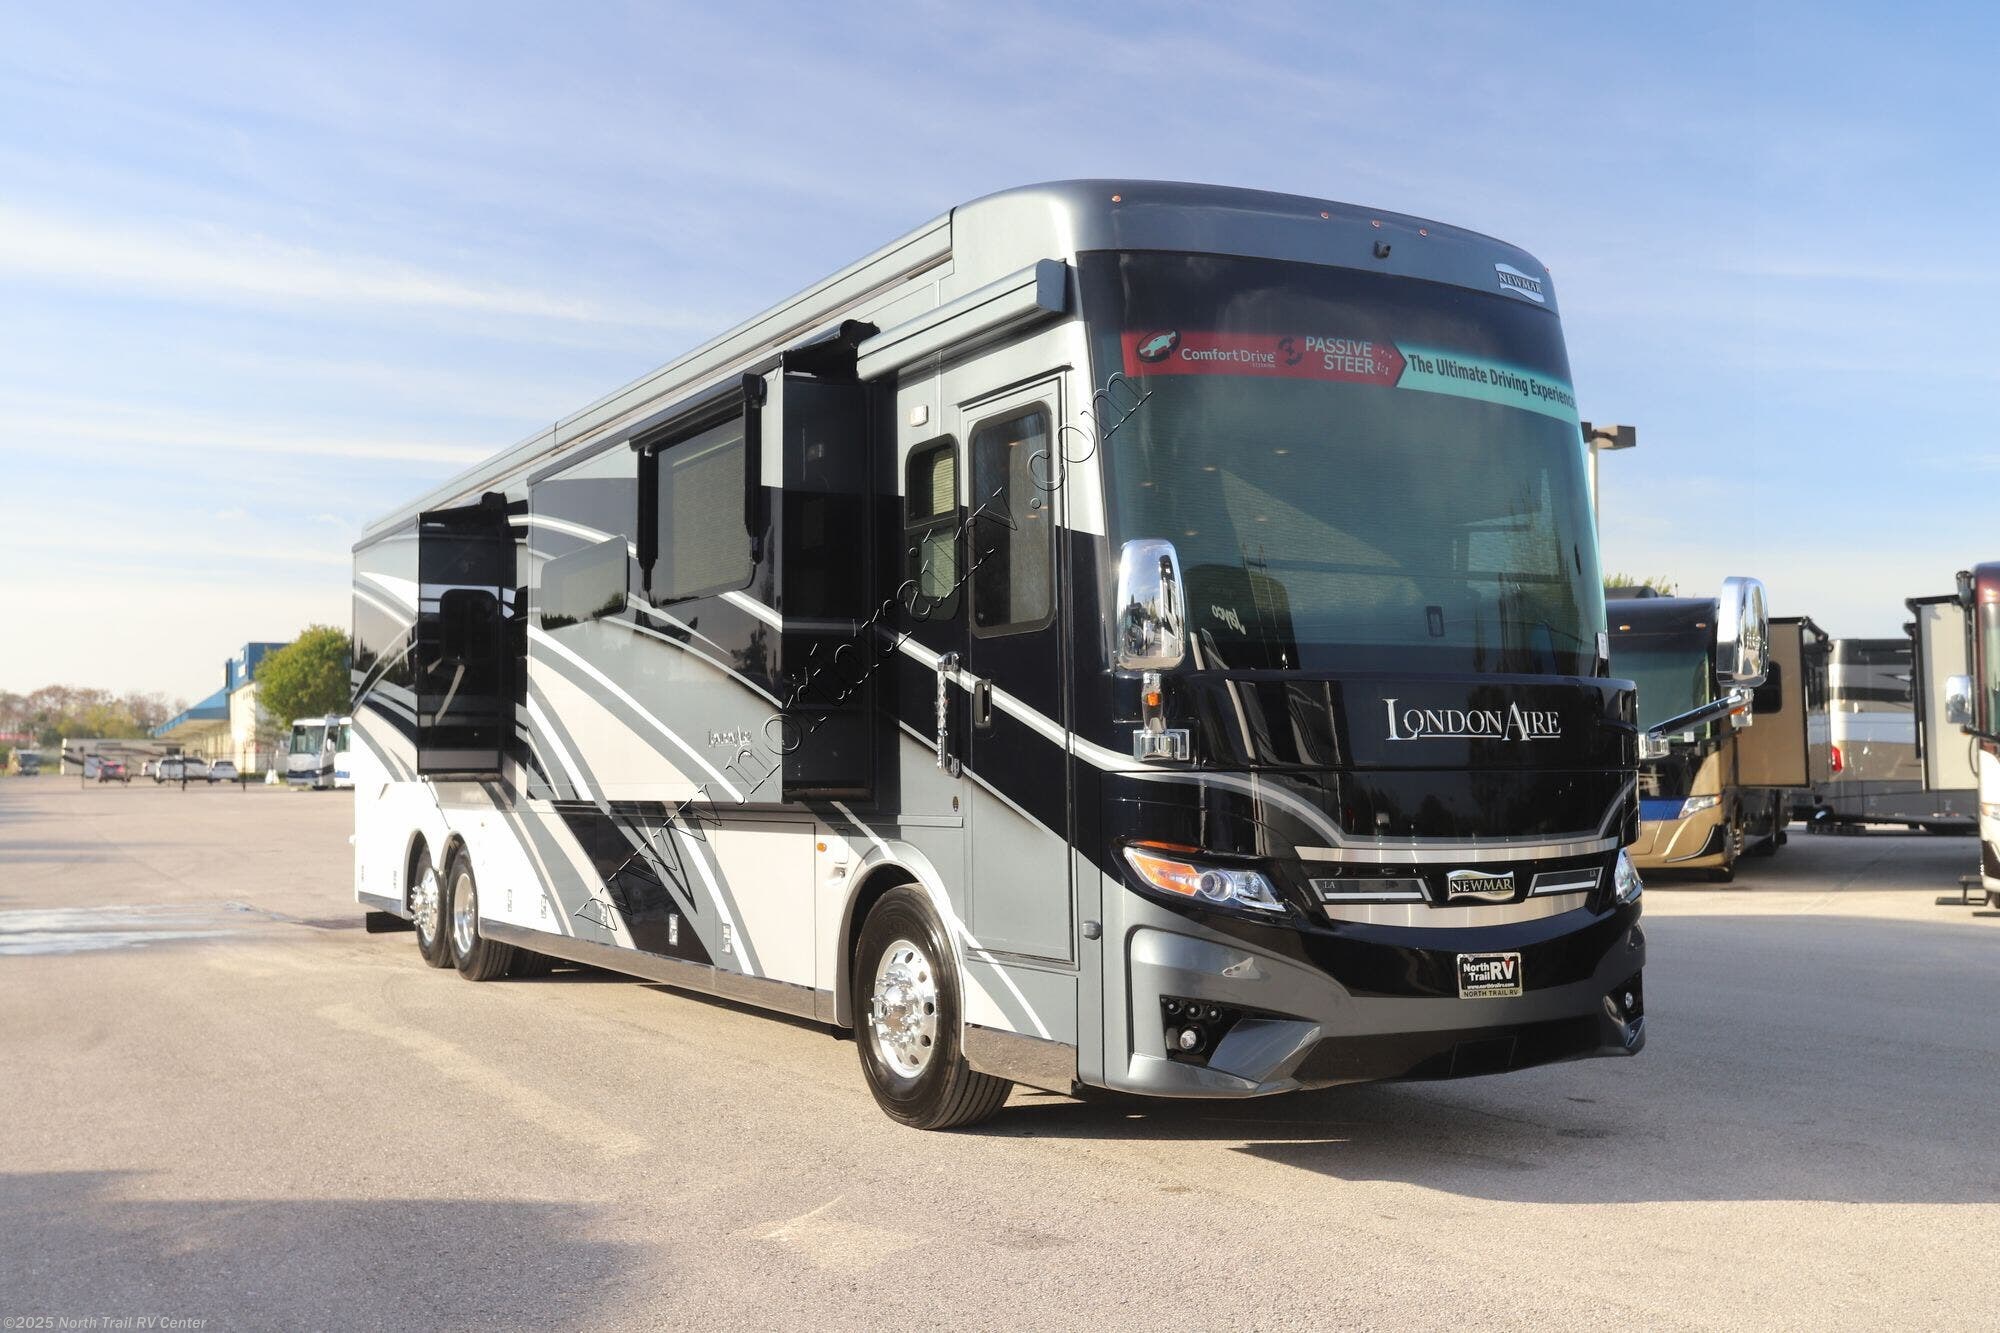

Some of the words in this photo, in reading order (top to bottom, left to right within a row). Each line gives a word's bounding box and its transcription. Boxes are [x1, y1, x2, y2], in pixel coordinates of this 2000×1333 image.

[1305, 336, 1373, 358] PASSIVE
[1323, 354, 1375, 375] STEER
[1408, 354, 1434, 374] The
[1436, 358, 1488, 384] Ultimate
[1490, 368, 1529, 397] Driving
[1450, 879, 1513, 893] NEWMAR
[1463, 962, 1490, 973] North
[1490, 961, 1515, 981] RV
[1468, 971, 1491, 981] Trail
[1464, 990, 1487, 998] NORTH
[1489, 989, 1508, 997] TRAIL
